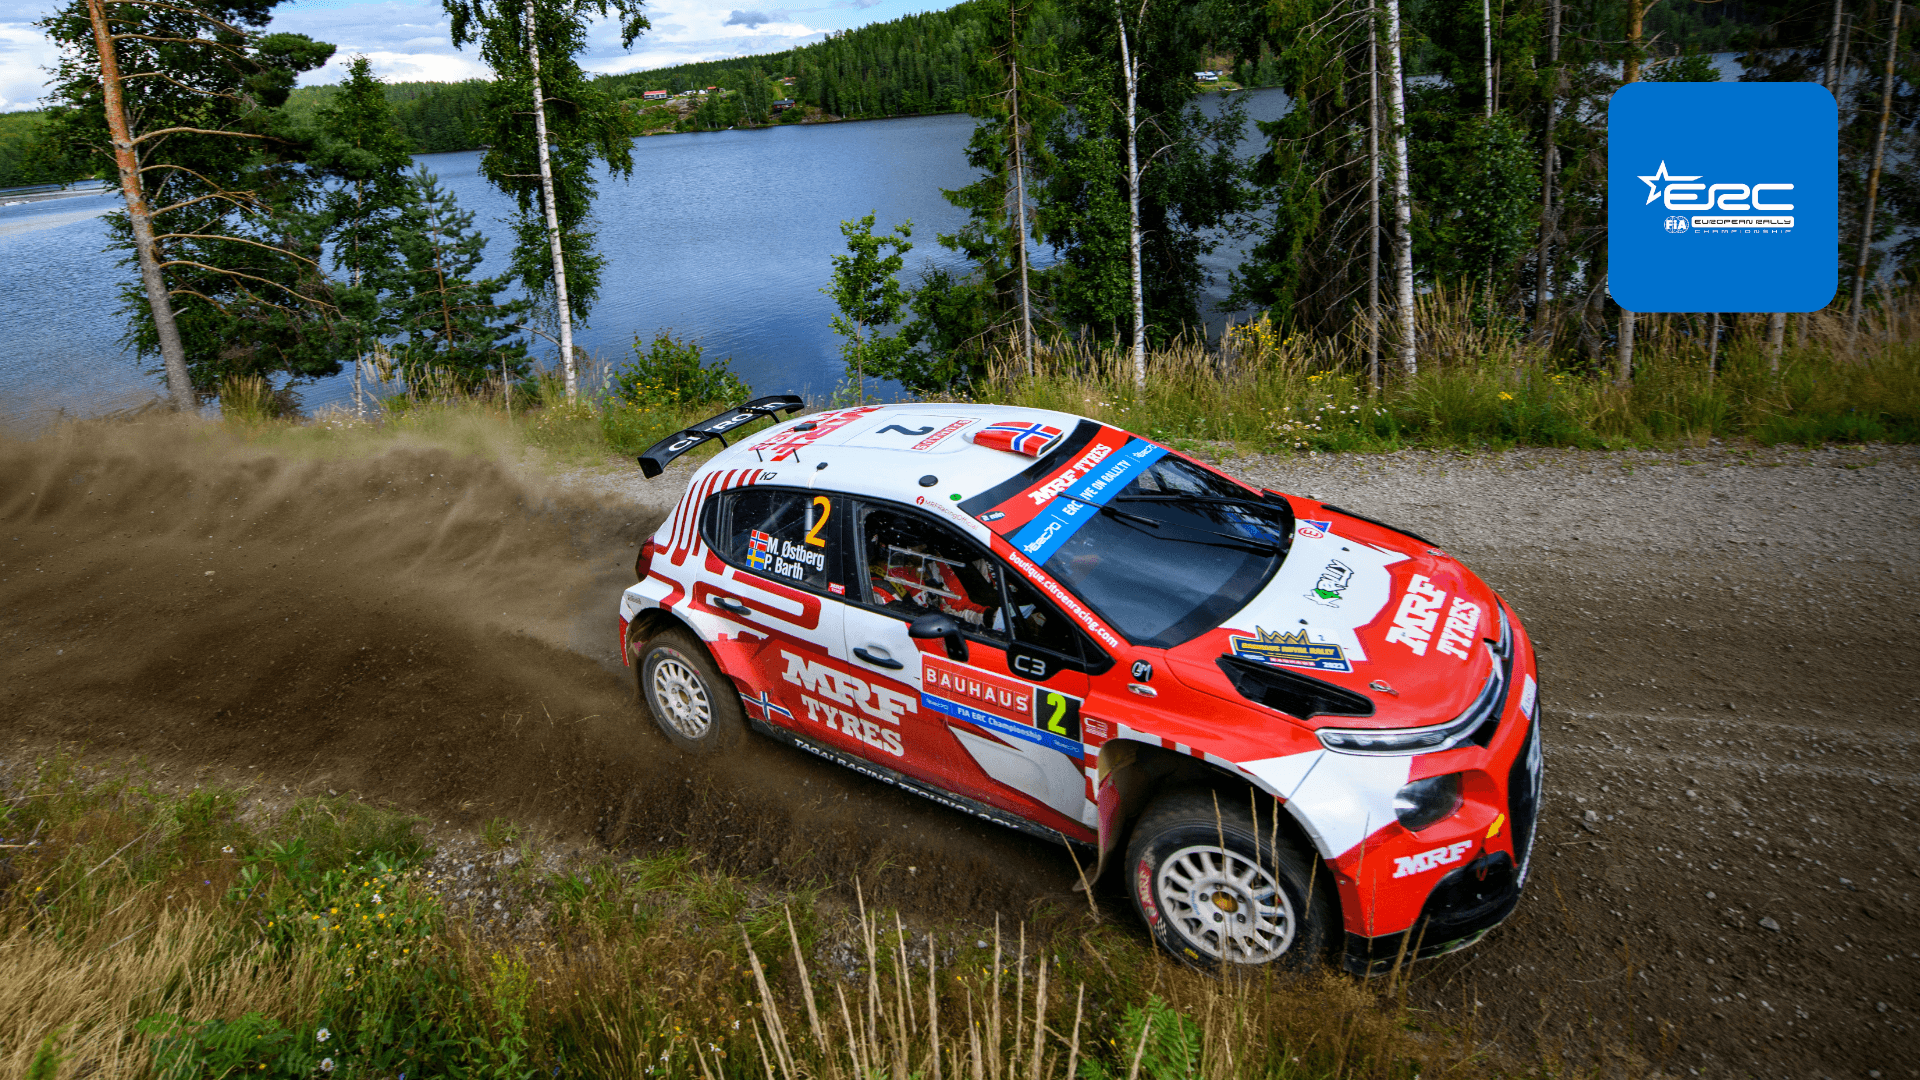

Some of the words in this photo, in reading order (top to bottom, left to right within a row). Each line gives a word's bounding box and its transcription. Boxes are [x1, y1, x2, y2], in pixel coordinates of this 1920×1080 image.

[875, 424, 935, 436] 2
[1027, 469, 1079, 506] MRF
[1073, 443, 1113, 473] TYRES
[1062, 500, 1085, 516] ERC
[1077, 486, 1099, 503] IVE
[1092, 479, 1108, 492] ON
[805, 496, 831, 548] 2
[763, 554, 773, 571] P.
[774, 557, 804, 580] Barth
[766, 537, 779, 556] M.
[781, 540, 825, 571] Østberg
[1008, 552, 1119, 648] boutique.citroenracing.com
[1385, 573, 1447, 656] MRF
[1436, 596, 1482, 661] TYRES
[780, 649, 918, 725] MRF
[1014, 654, 1046, 676] C3
[926, 668, 1029, 713] BAUHAUS
[800, 694, 905, 757] TYRES
[957, 707, 971, 718] FIA
[971, 711, 987, 723] ERC
[988, 715, 1043, 742] Championship
[1047, 692, 1067, 736] 2
[837, 758, 894, 785] RACING
[1392, 840, 1472, 879] MRF
